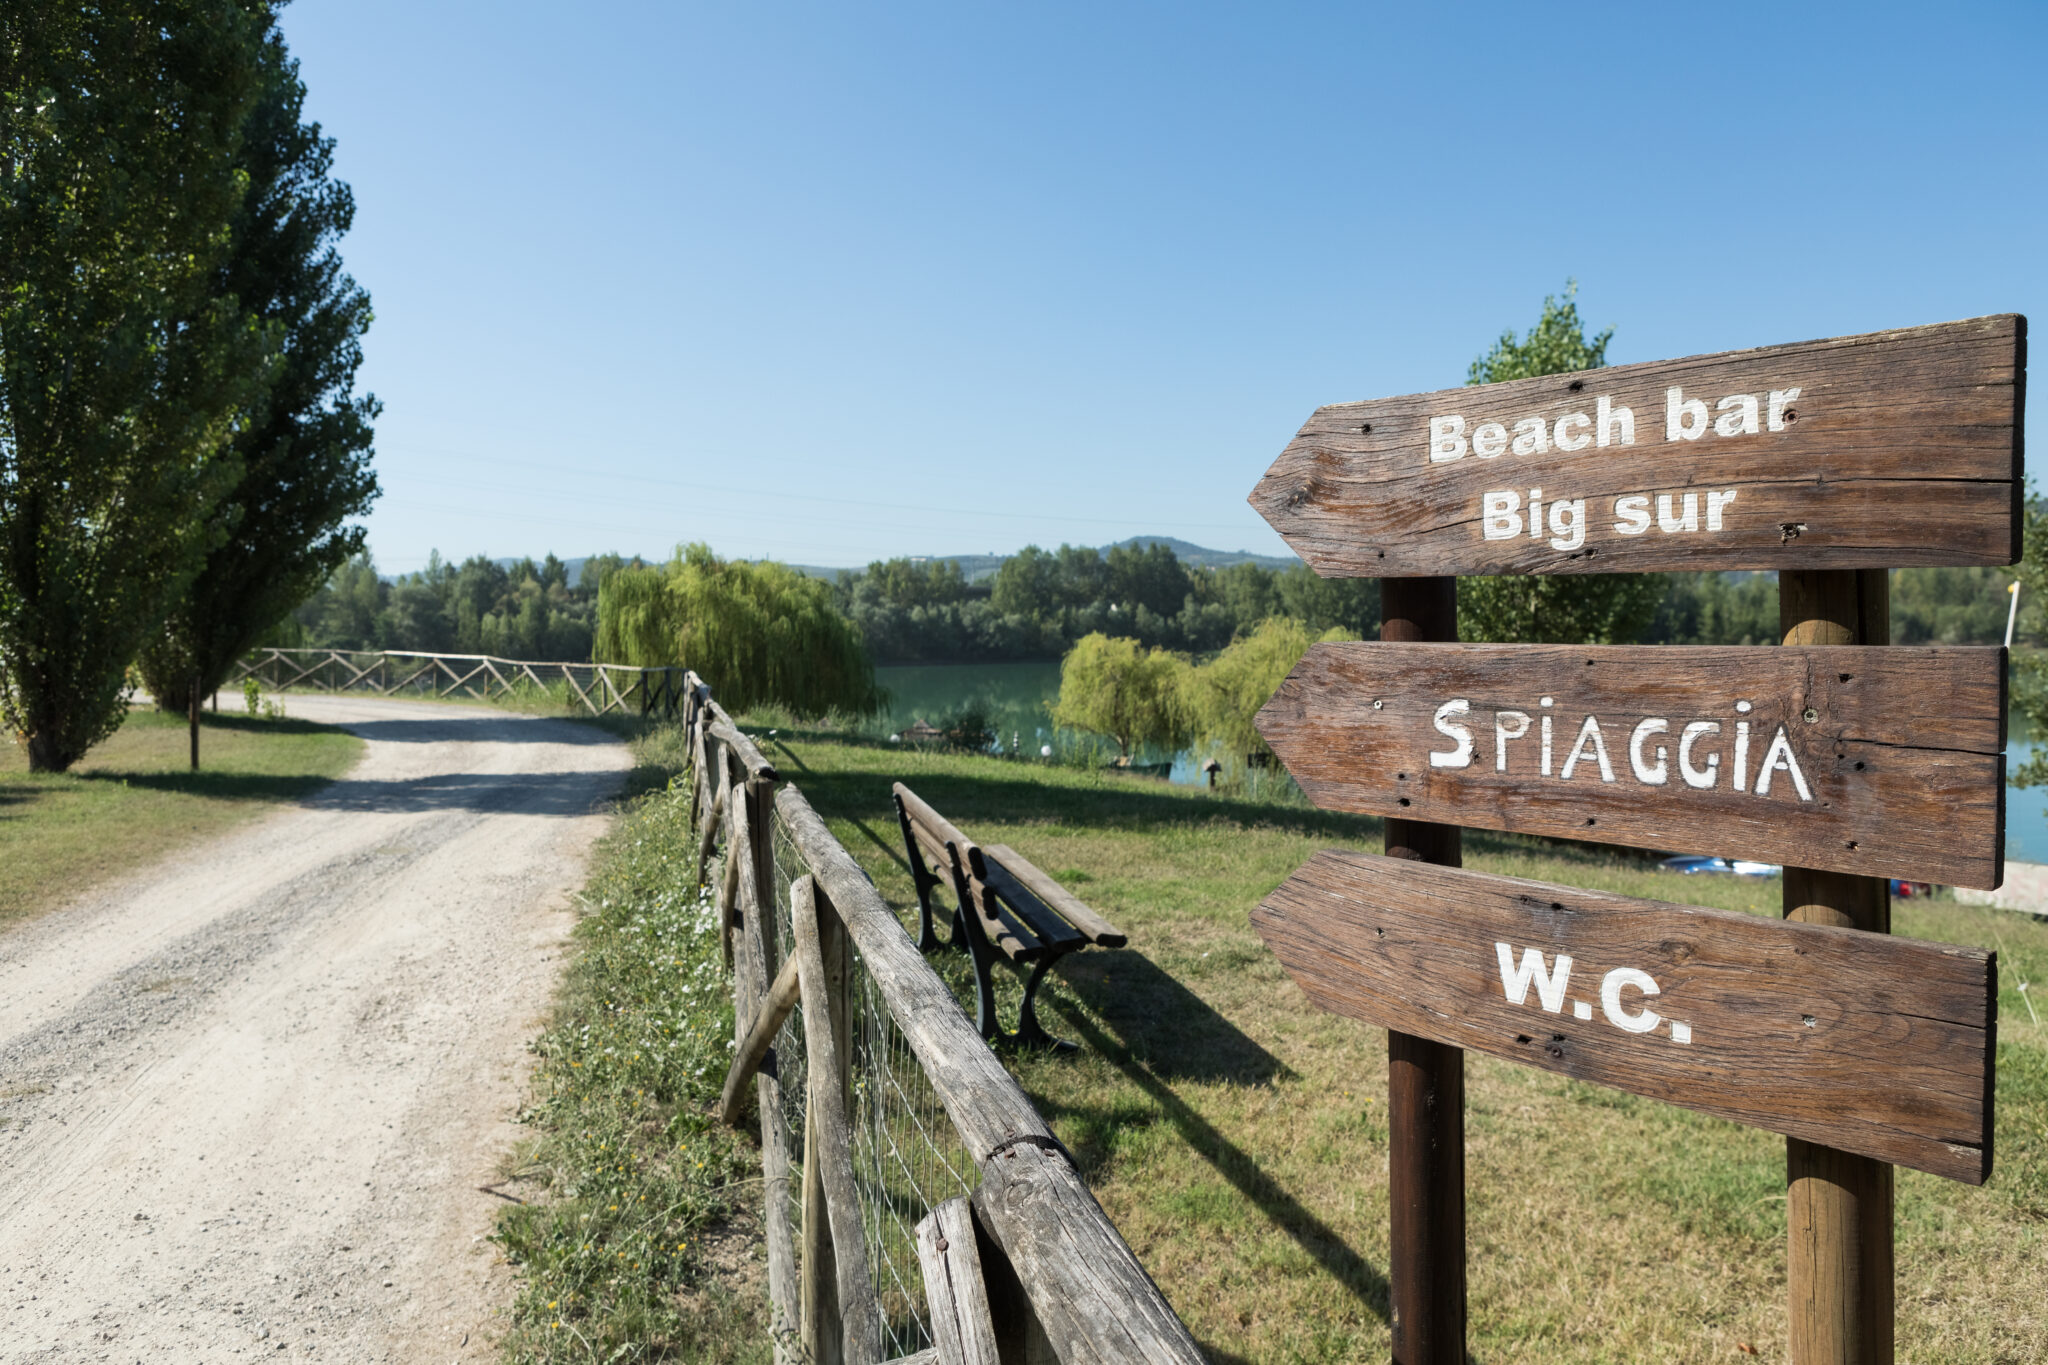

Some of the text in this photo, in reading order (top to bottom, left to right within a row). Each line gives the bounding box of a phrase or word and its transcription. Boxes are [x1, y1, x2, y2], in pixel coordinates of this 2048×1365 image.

[1429, 386, 1803, 463] Beach bar
[1483, 488, 1737, 551] Big sur
[1495, 942, 1692, 1044] W.C.
